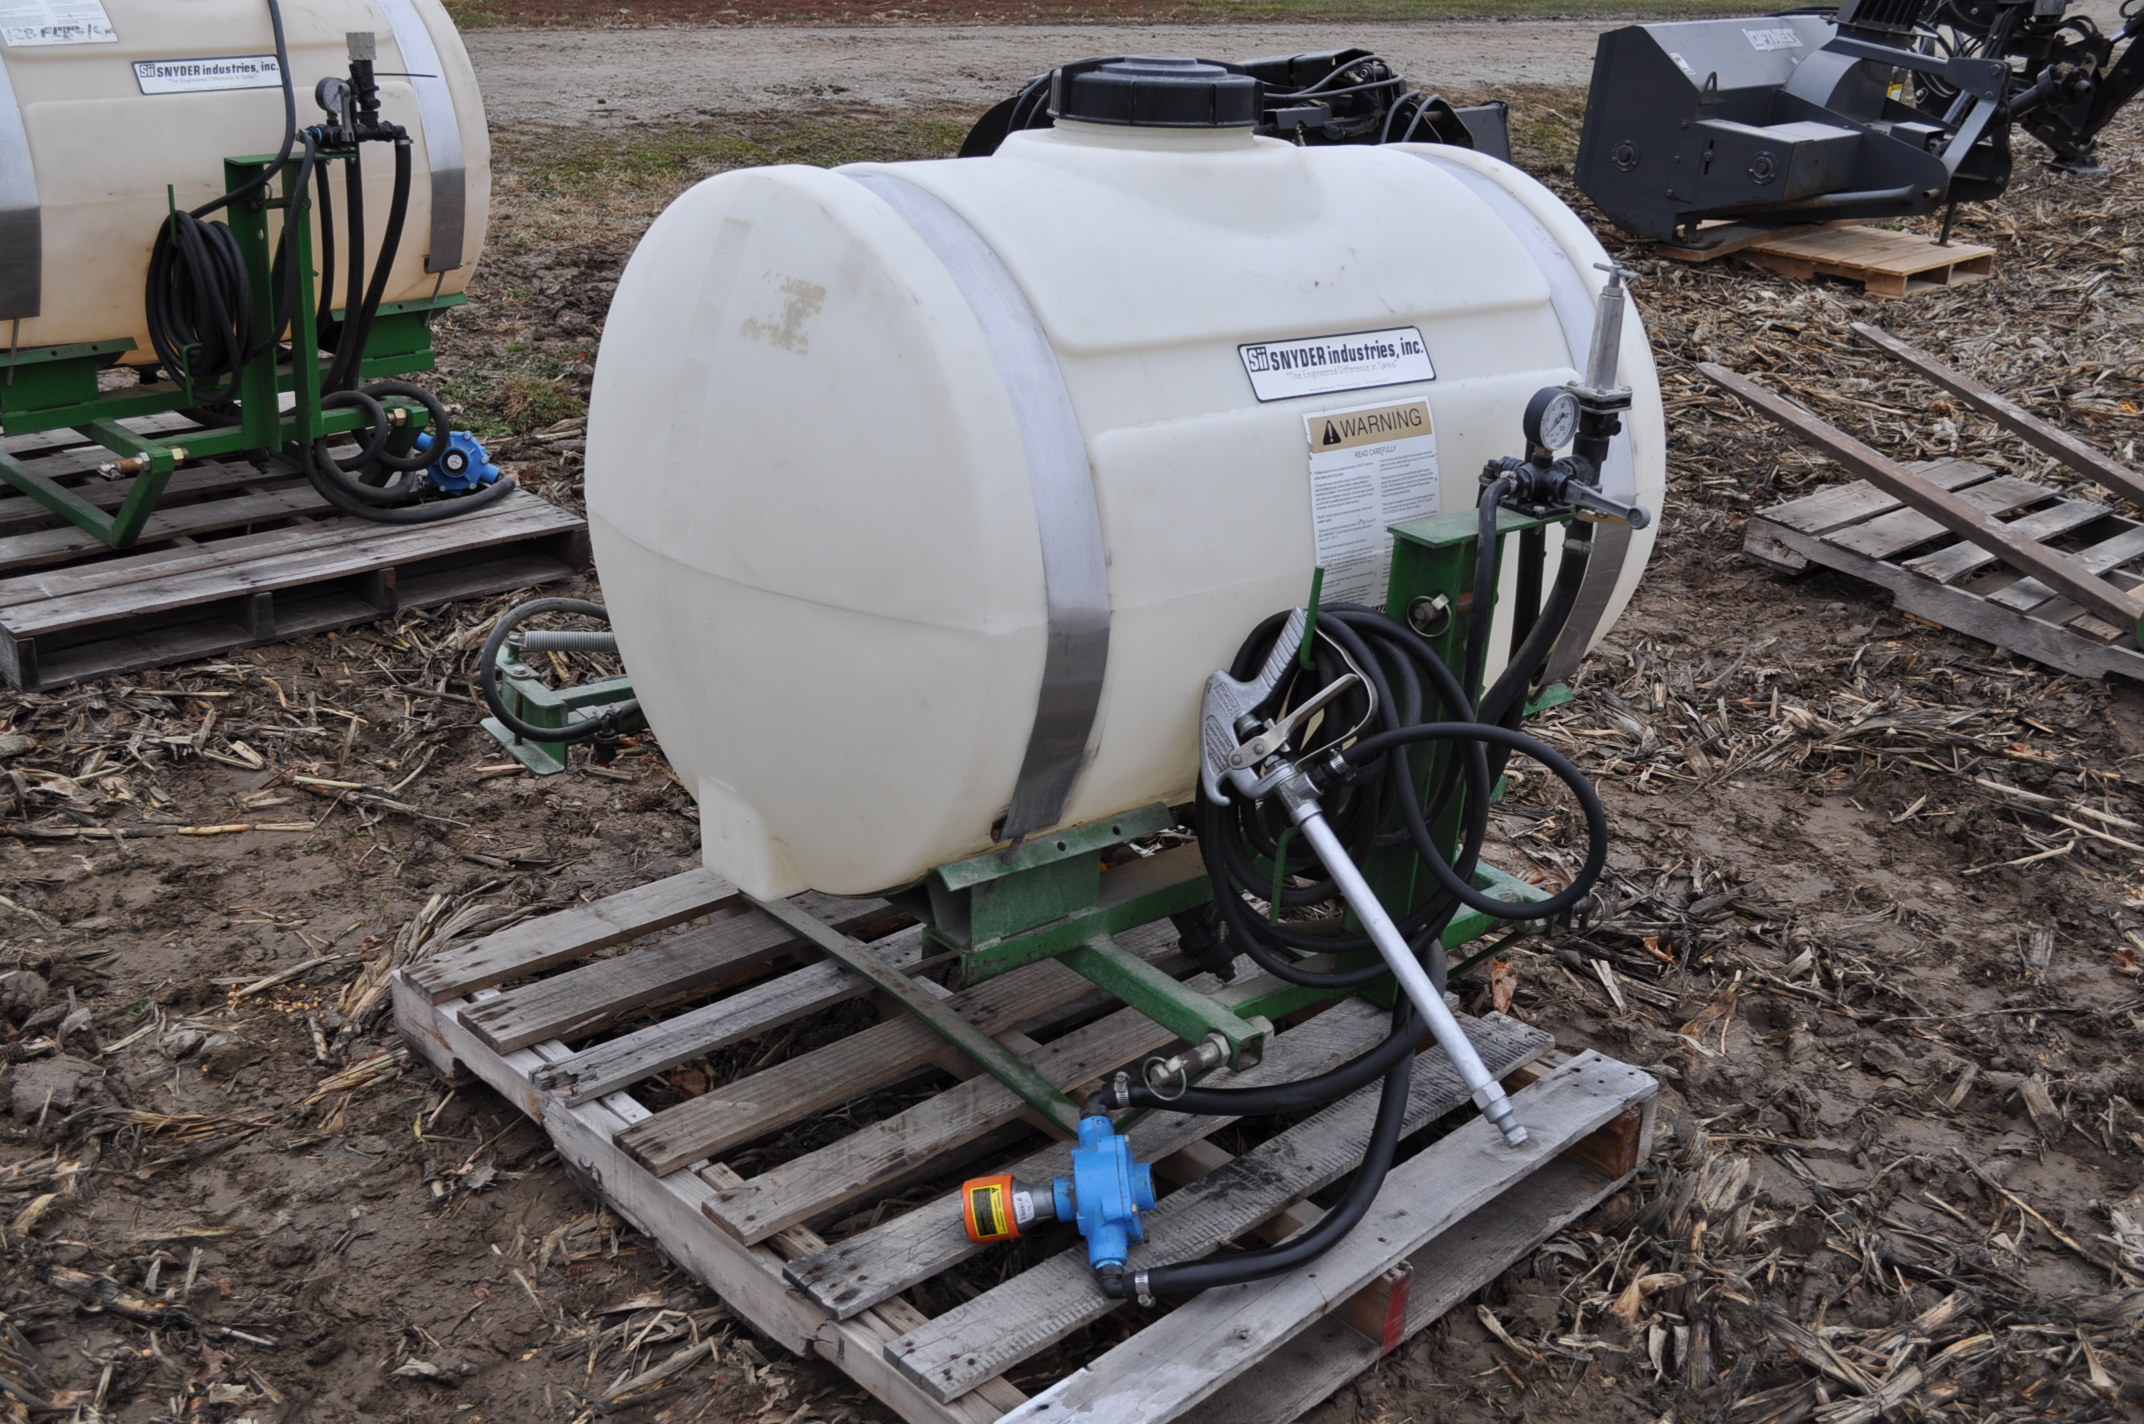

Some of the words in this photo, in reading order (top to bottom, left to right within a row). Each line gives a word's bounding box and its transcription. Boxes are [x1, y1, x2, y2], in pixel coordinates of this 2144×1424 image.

[157, 65, 200, 78] SNYDER
[202, 62, 259, 75] industries,
[260, 61, 279, 72] inc.
[1270, 346, 1327, 371] SNYDER
[1326, 339, 1399, 364] industries,
[1400, 337, 1424, 356] inc.
[1340, 408, 1422, 438] WARNING
[1354, 449, 1369, 458] READ
[1369, 445, 1397, 456] CAREFULLY
